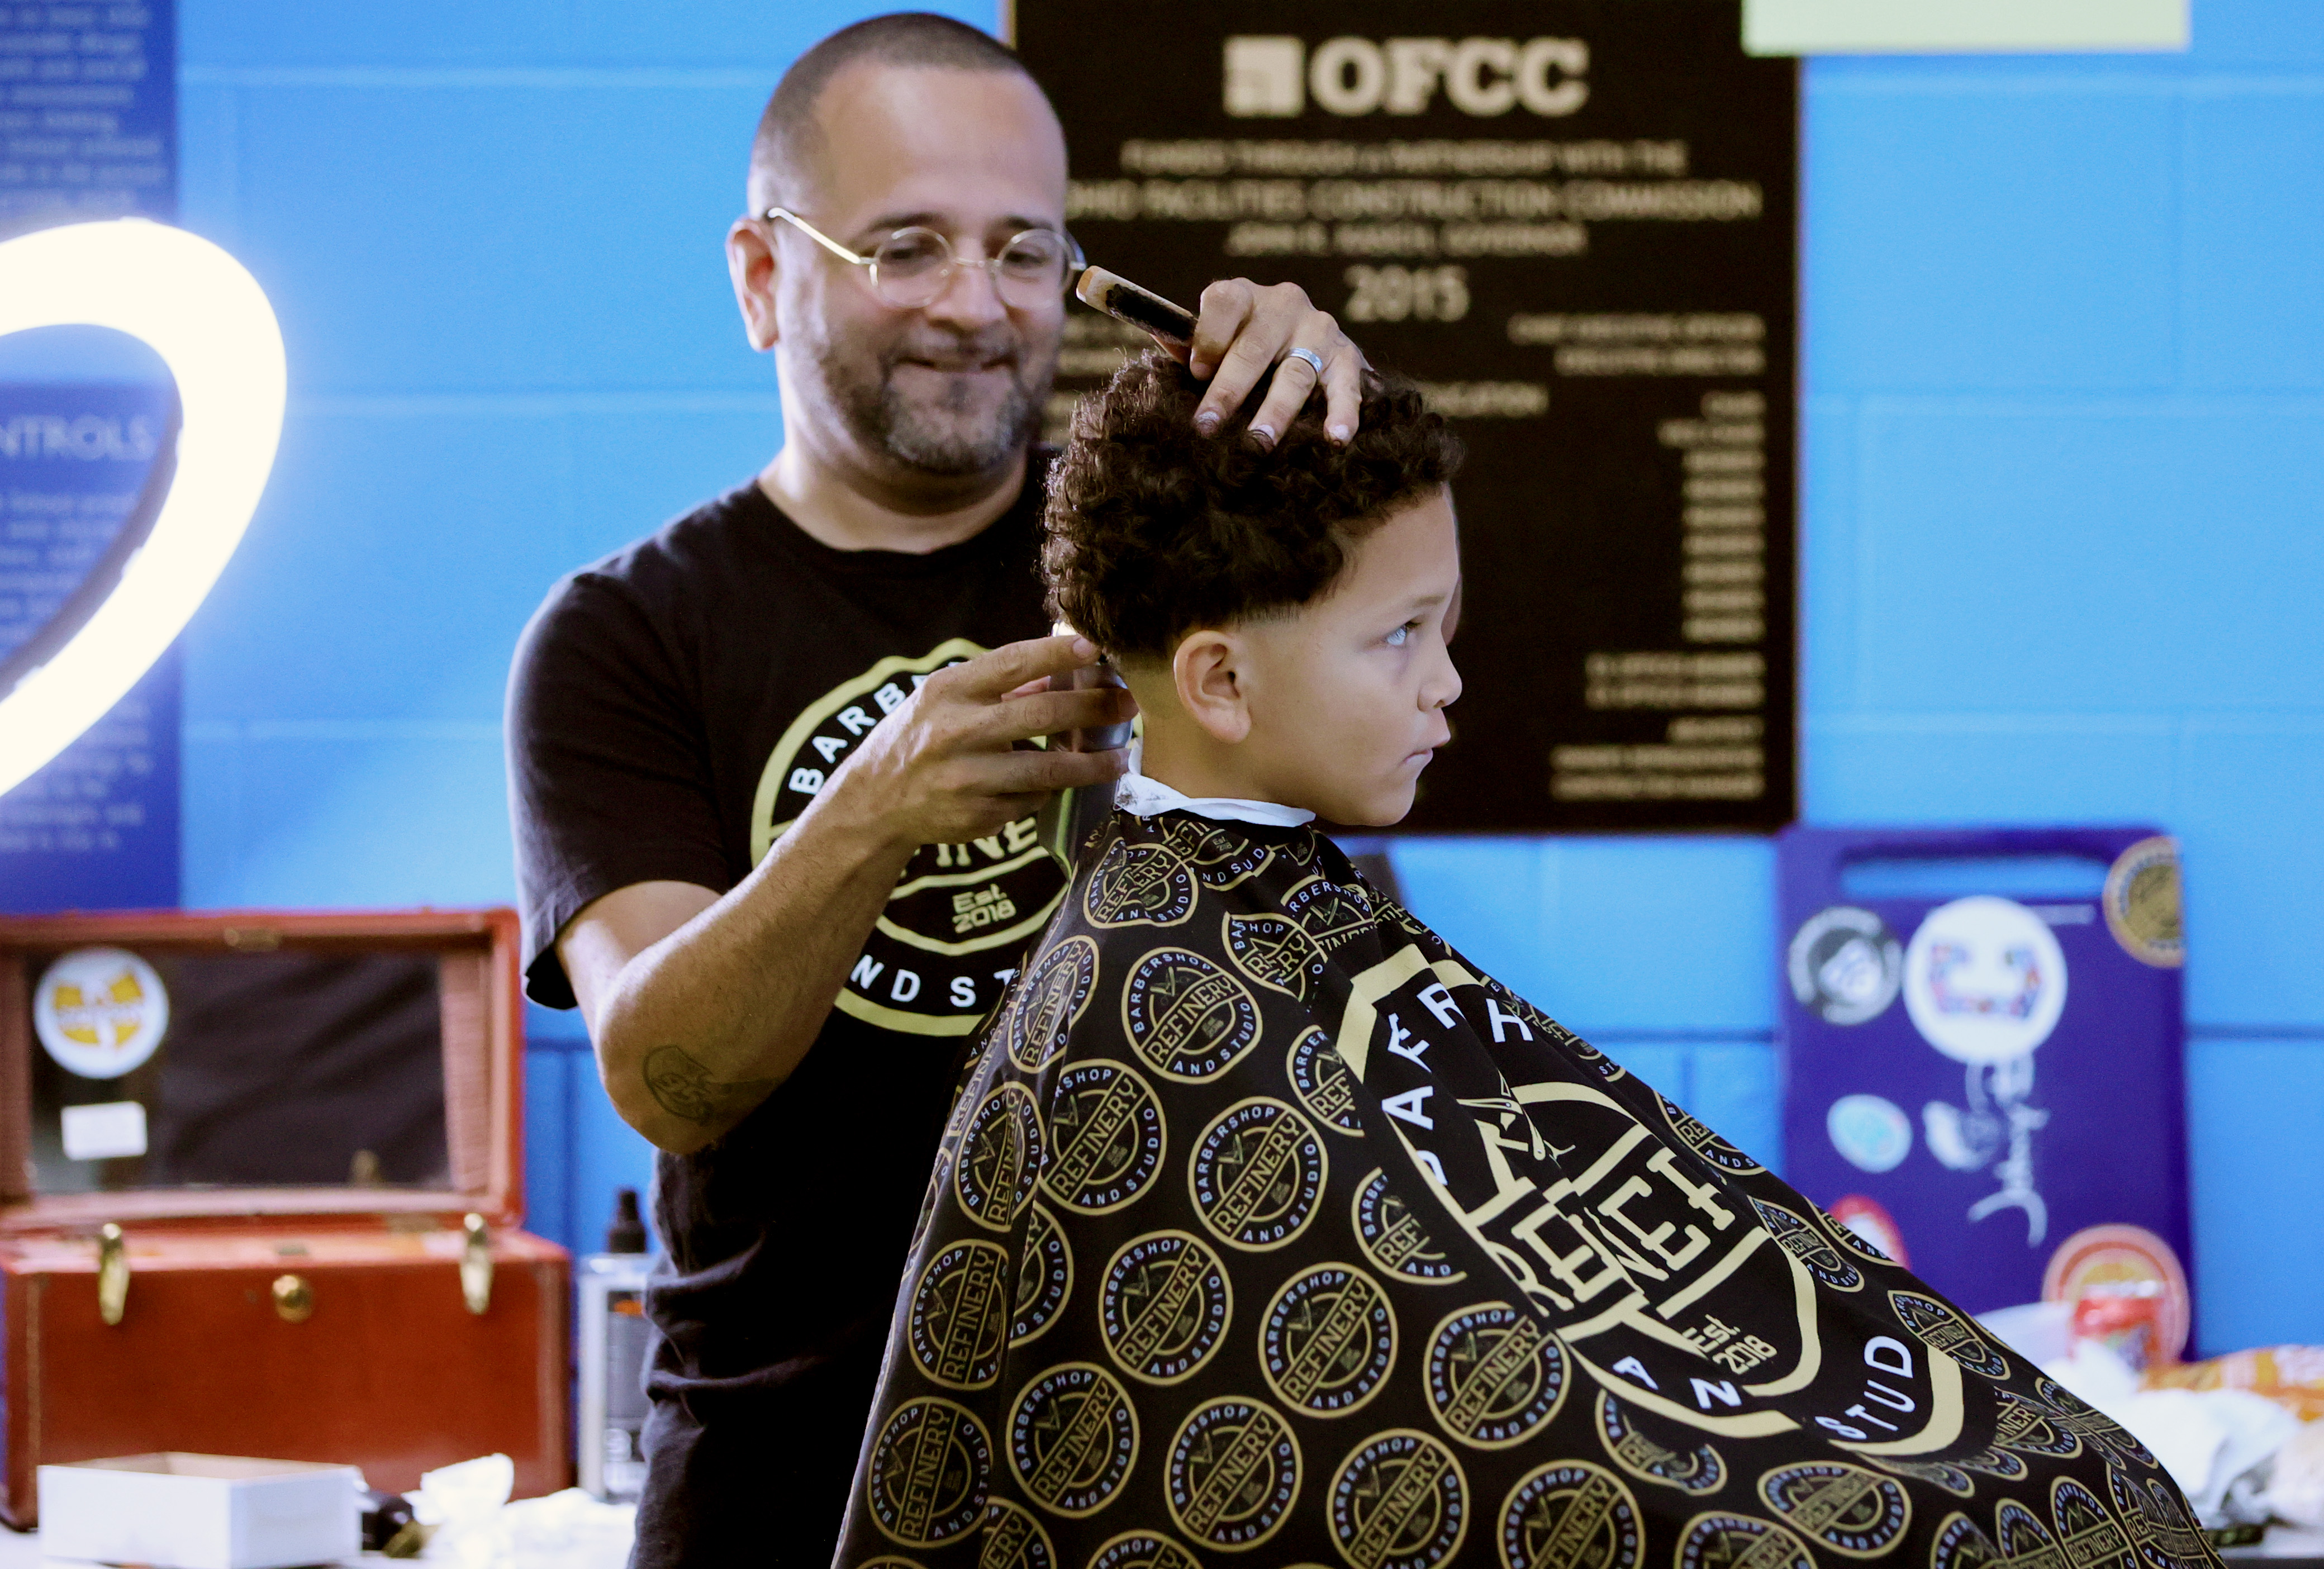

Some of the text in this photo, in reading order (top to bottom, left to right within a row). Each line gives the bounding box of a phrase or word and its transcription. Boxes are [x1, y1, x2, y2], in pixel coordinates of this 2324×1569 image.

[1310, 36, 1590, 115] OFCC
[1343, 263, 1471, 322] 2015
[952, 896, 1016, 934] 2018
[1158, 874, 1189, 921] STUDIO
[850, 954, 921, 1002] ND
[1024, 943, 1084, 1064] REFINERY
[1132, 953, 1212, 1034] BARBERSHOP
[1147, 977, 1237, 1065] REFINERY
[1172, 1059, 1216, 1074] AND
[1220, 1001, 1254, 1060] STUDIO
[1024, 1104, 1040, 1186] STUDIO
[1051, 1077, 1138, 1196] REFINERY
[1081, 1107, 1159, 1206] AND STUDIO
[1196, 1106, 1276, 1204] BARBERSHOP
[1214, 1115, 1301, 1233] REFINERY
[1243, 1143, 1321, 1243] AND STUDIO
[914, 1248, 964, 1363] BARBERSHOP
[942, 1249, 995, 1380] REFINERY
[1033, 1240, 1070, 1326] STUDIO
[1104, 1239, 1182, 1337] BARBERSHOP
[1118, 1249, 1203, 1370] REFINERY
[1406, 1262, 1452, 1278] AND
[1150, 1275, 1224, 1376] AND STUDIO
[1266, 1271, 1345, 1372] BARBERSHOP
[1284, 1278, 1368, 1400] REFINERY
[1014, 1371, 1092, 1471] BARBERSHOP
[1312, 1390, 1354, 1409] AND
[1449, 1320, 1541, 1430] REFINERY
[872, 1406, 919, 1523] BARBERSHOP
[912, 1406, 962, 1537] REFINERY
[1034, 1380, 1112, 1498] REFINERY
[1187, 1415, 1273, 1533] REFINERY
[1477, 1419, 1520, 1438] AND
[934, 1509, 974, 1537] AND
[1063, 1492, 1100, 1508] AND
[1216, 1524, 1257, 1541] AND
[1352, 1448, 1441, 1567] REFINERY
